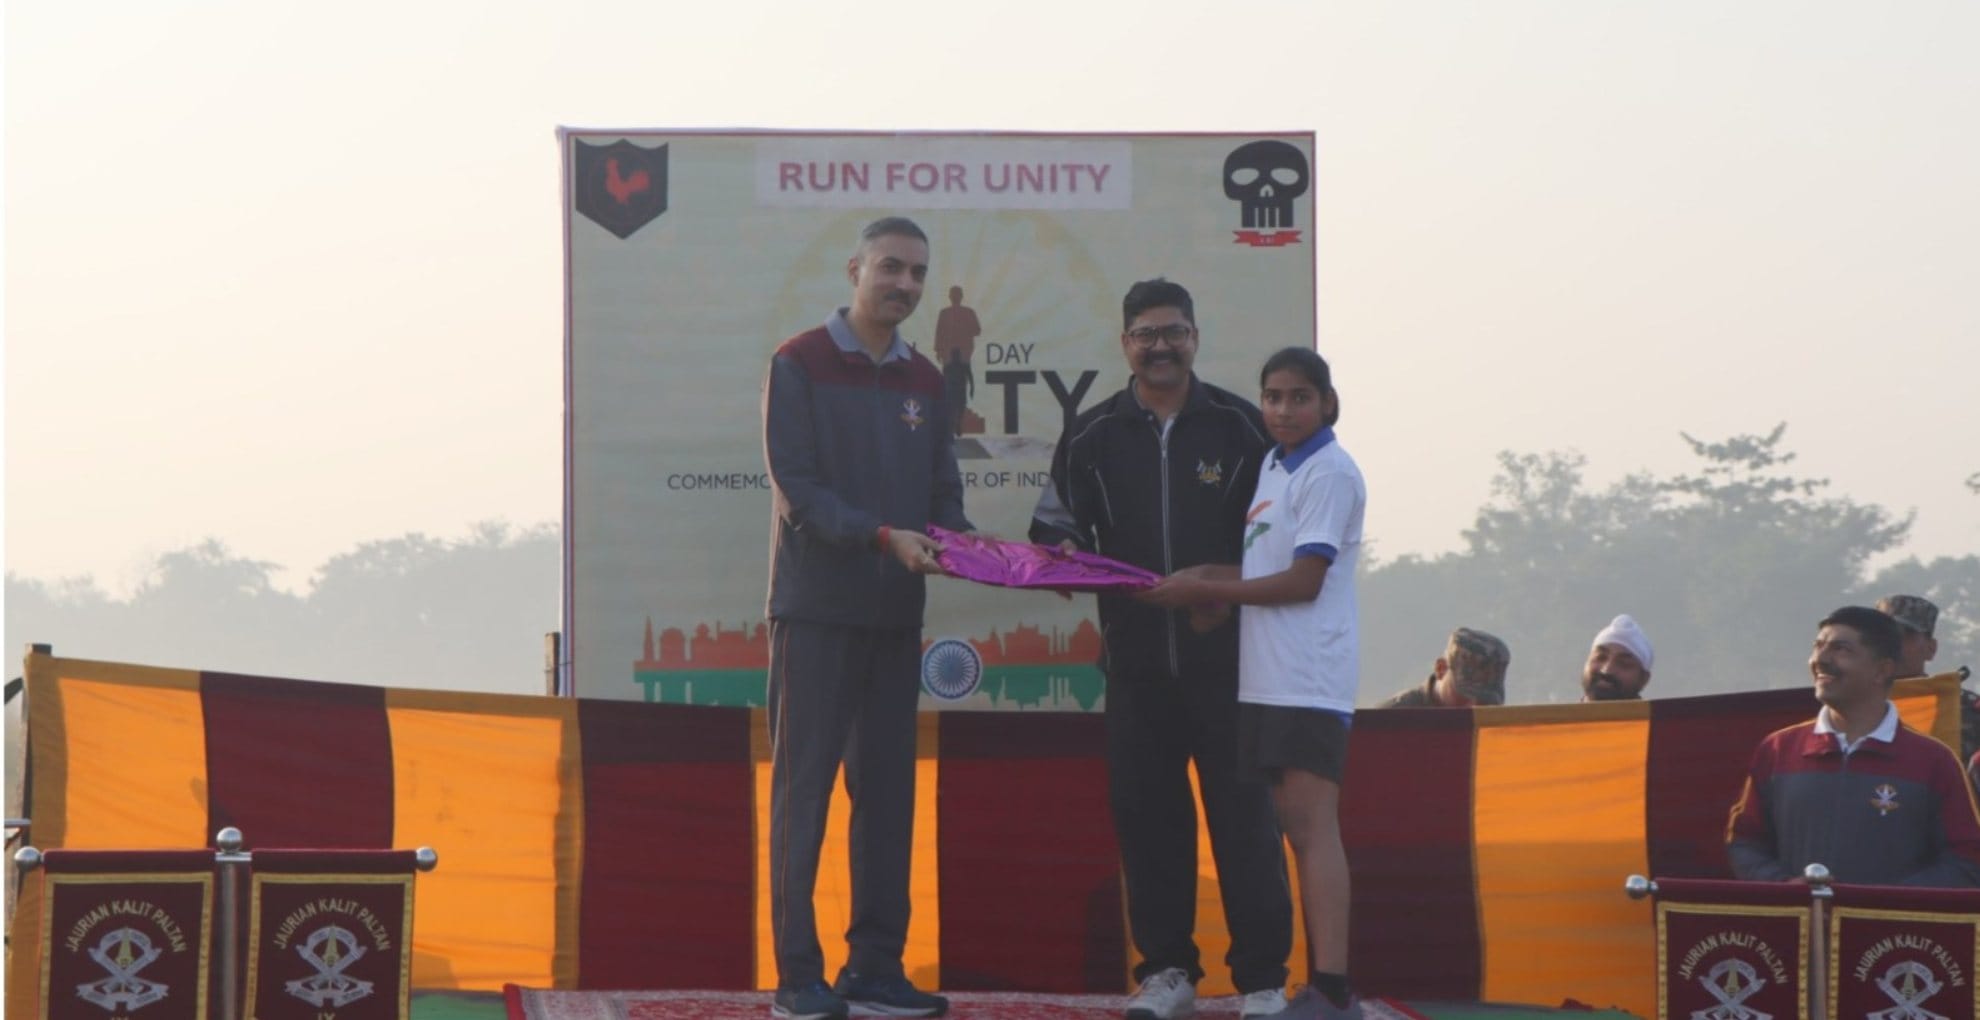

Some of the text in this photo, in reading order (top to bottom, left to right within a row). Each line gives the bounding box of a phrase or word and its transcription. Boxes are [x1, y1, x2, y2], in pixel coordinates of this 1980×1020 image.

[779, 162, 1112, 193] RUN FOR UNITY
[986, 343, 1034, 365] DAY
[984, 471, 1010, 488] OF
[65, 899, 187, 953] JAURIAN KALIT PALTAN
[273, 898, 391, 952] JAURIAN KALIT PALTAN
[1678, 931, 1789, 984] JAURIAN KALIT PALTAN
[1854, 934, 1966, 987] JAURIAN KALIT PALTAN
